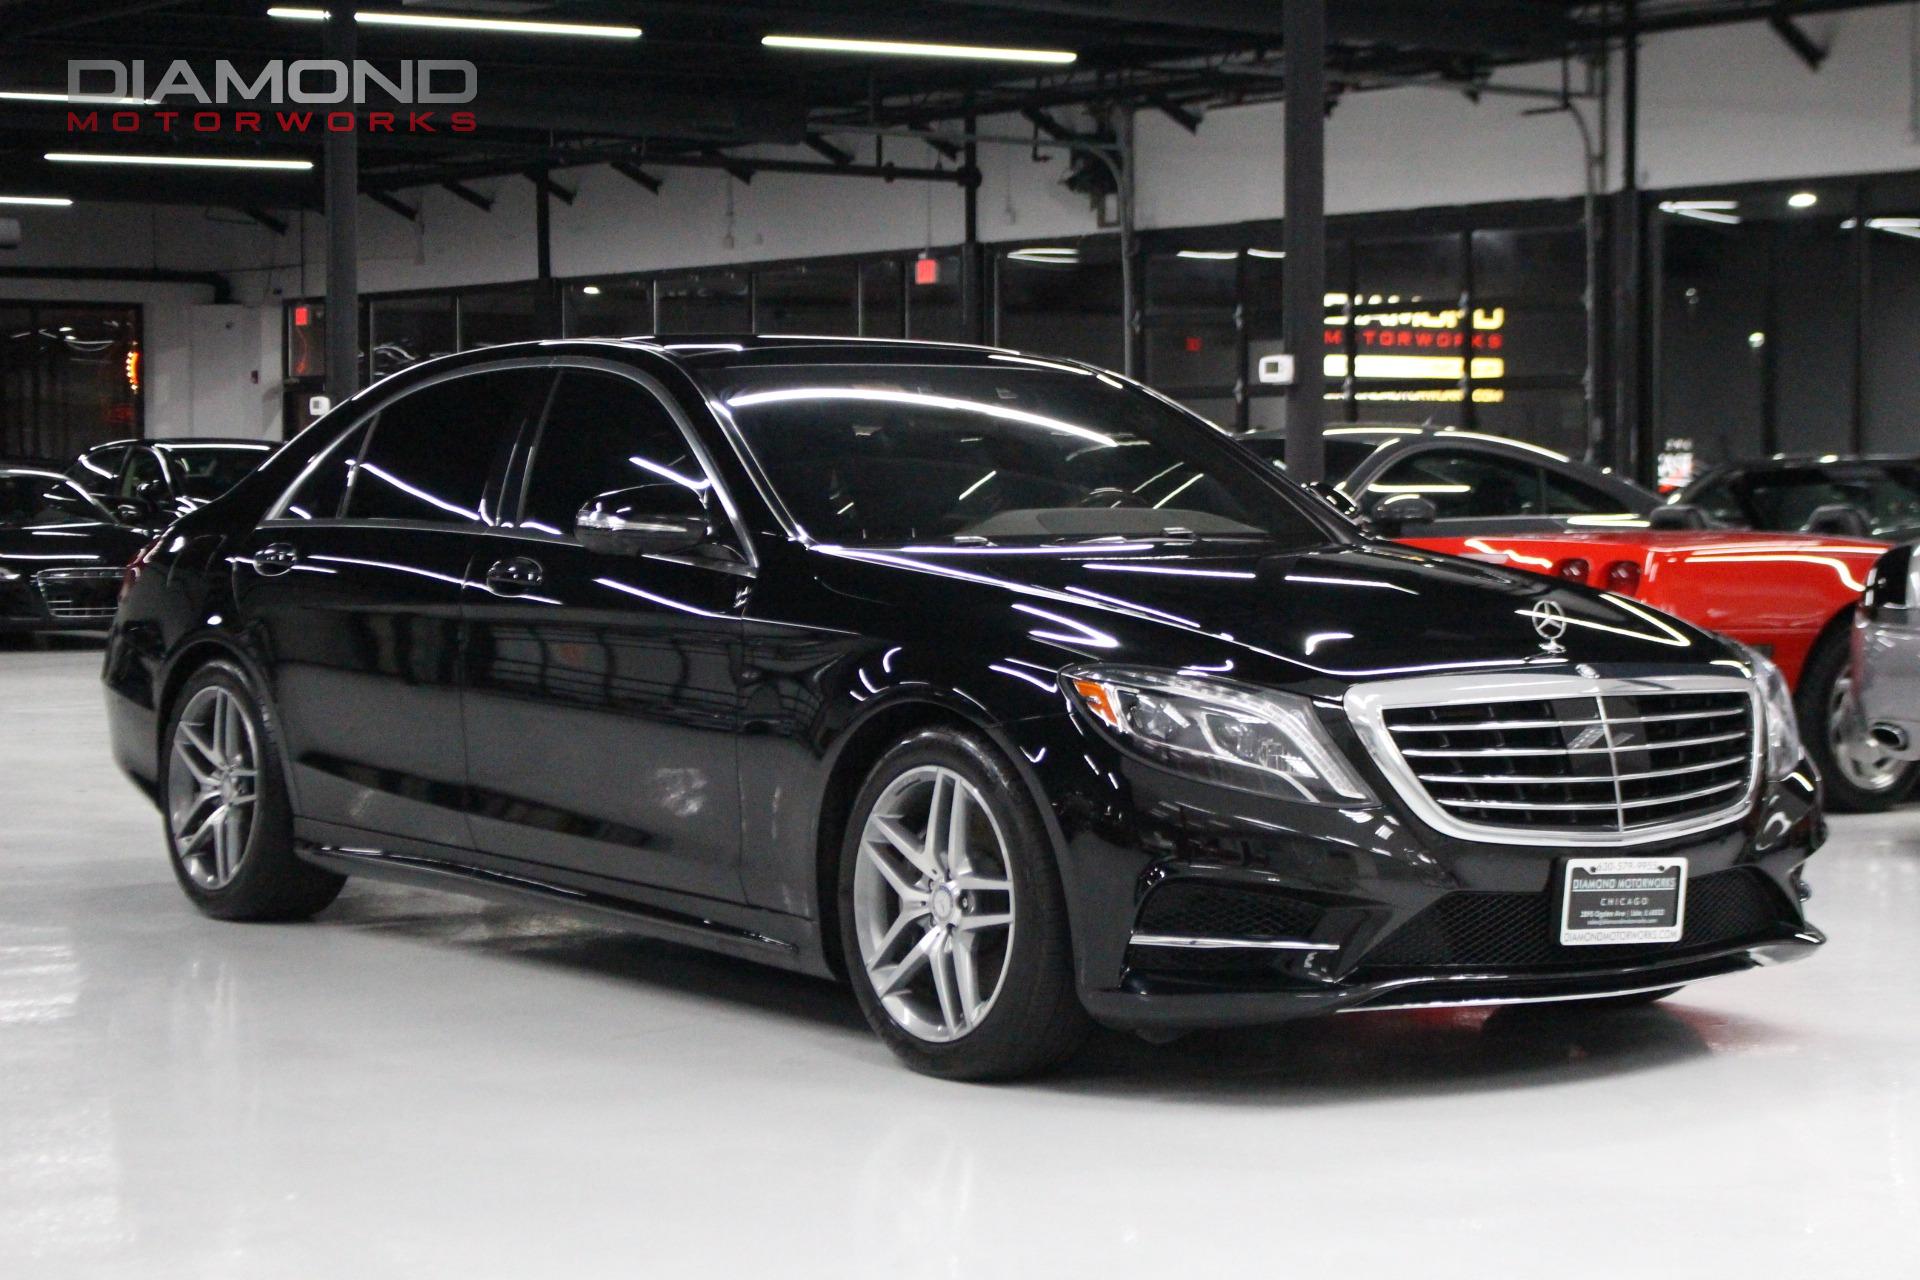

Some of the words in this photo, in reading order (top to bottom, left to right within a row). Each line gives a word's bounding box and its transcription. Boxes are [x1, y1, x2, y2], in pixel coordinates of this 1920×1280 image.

[1324, 330, 1503, 348] MTORWOKS
[1573, 879, 1616, 889] DIAMOND
[1617, 877, 1676, 888] MOTORWORKS
[1600, 897, 1648, 906] CHICAGO
[1564, 930, 1677, 942] DIAMONDMOTORWORKS.COM
